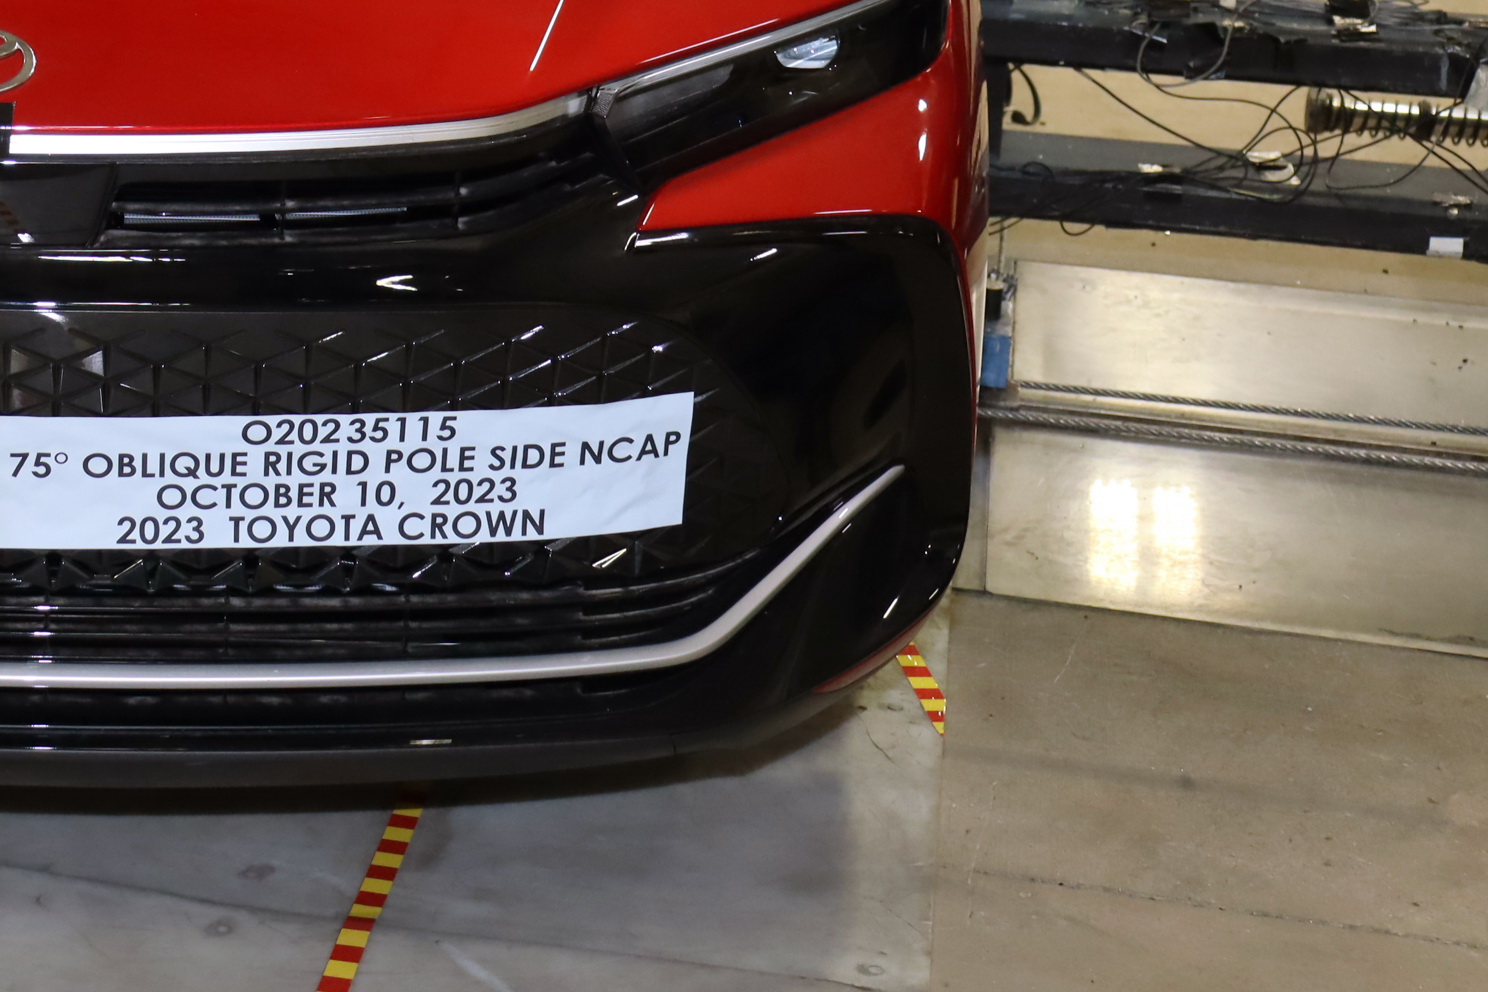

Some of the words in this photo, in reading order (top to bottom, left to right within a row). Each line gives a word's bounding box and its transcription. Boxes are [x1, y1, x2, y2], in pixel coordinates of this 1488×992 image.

[9, 451, 69, 478] 75°
[82, 451, 249, 479] OBLIQUE
[263, 449, 370, 477] RIGID
[384, 446, 476, 474] POLE
[488, 441, 567, 472] SIDE
[579, 431, 682, 466] NCAP
[156, 481, 337, 510] OCTOBER
[356, 480, 405, 510] 10,
[430, 476, 518, 506] 2023
[116, 515, 205, 545] 2023
[229, 514, 384, 544] TOYOTA
[398, 508, 546, 540] CROWN
